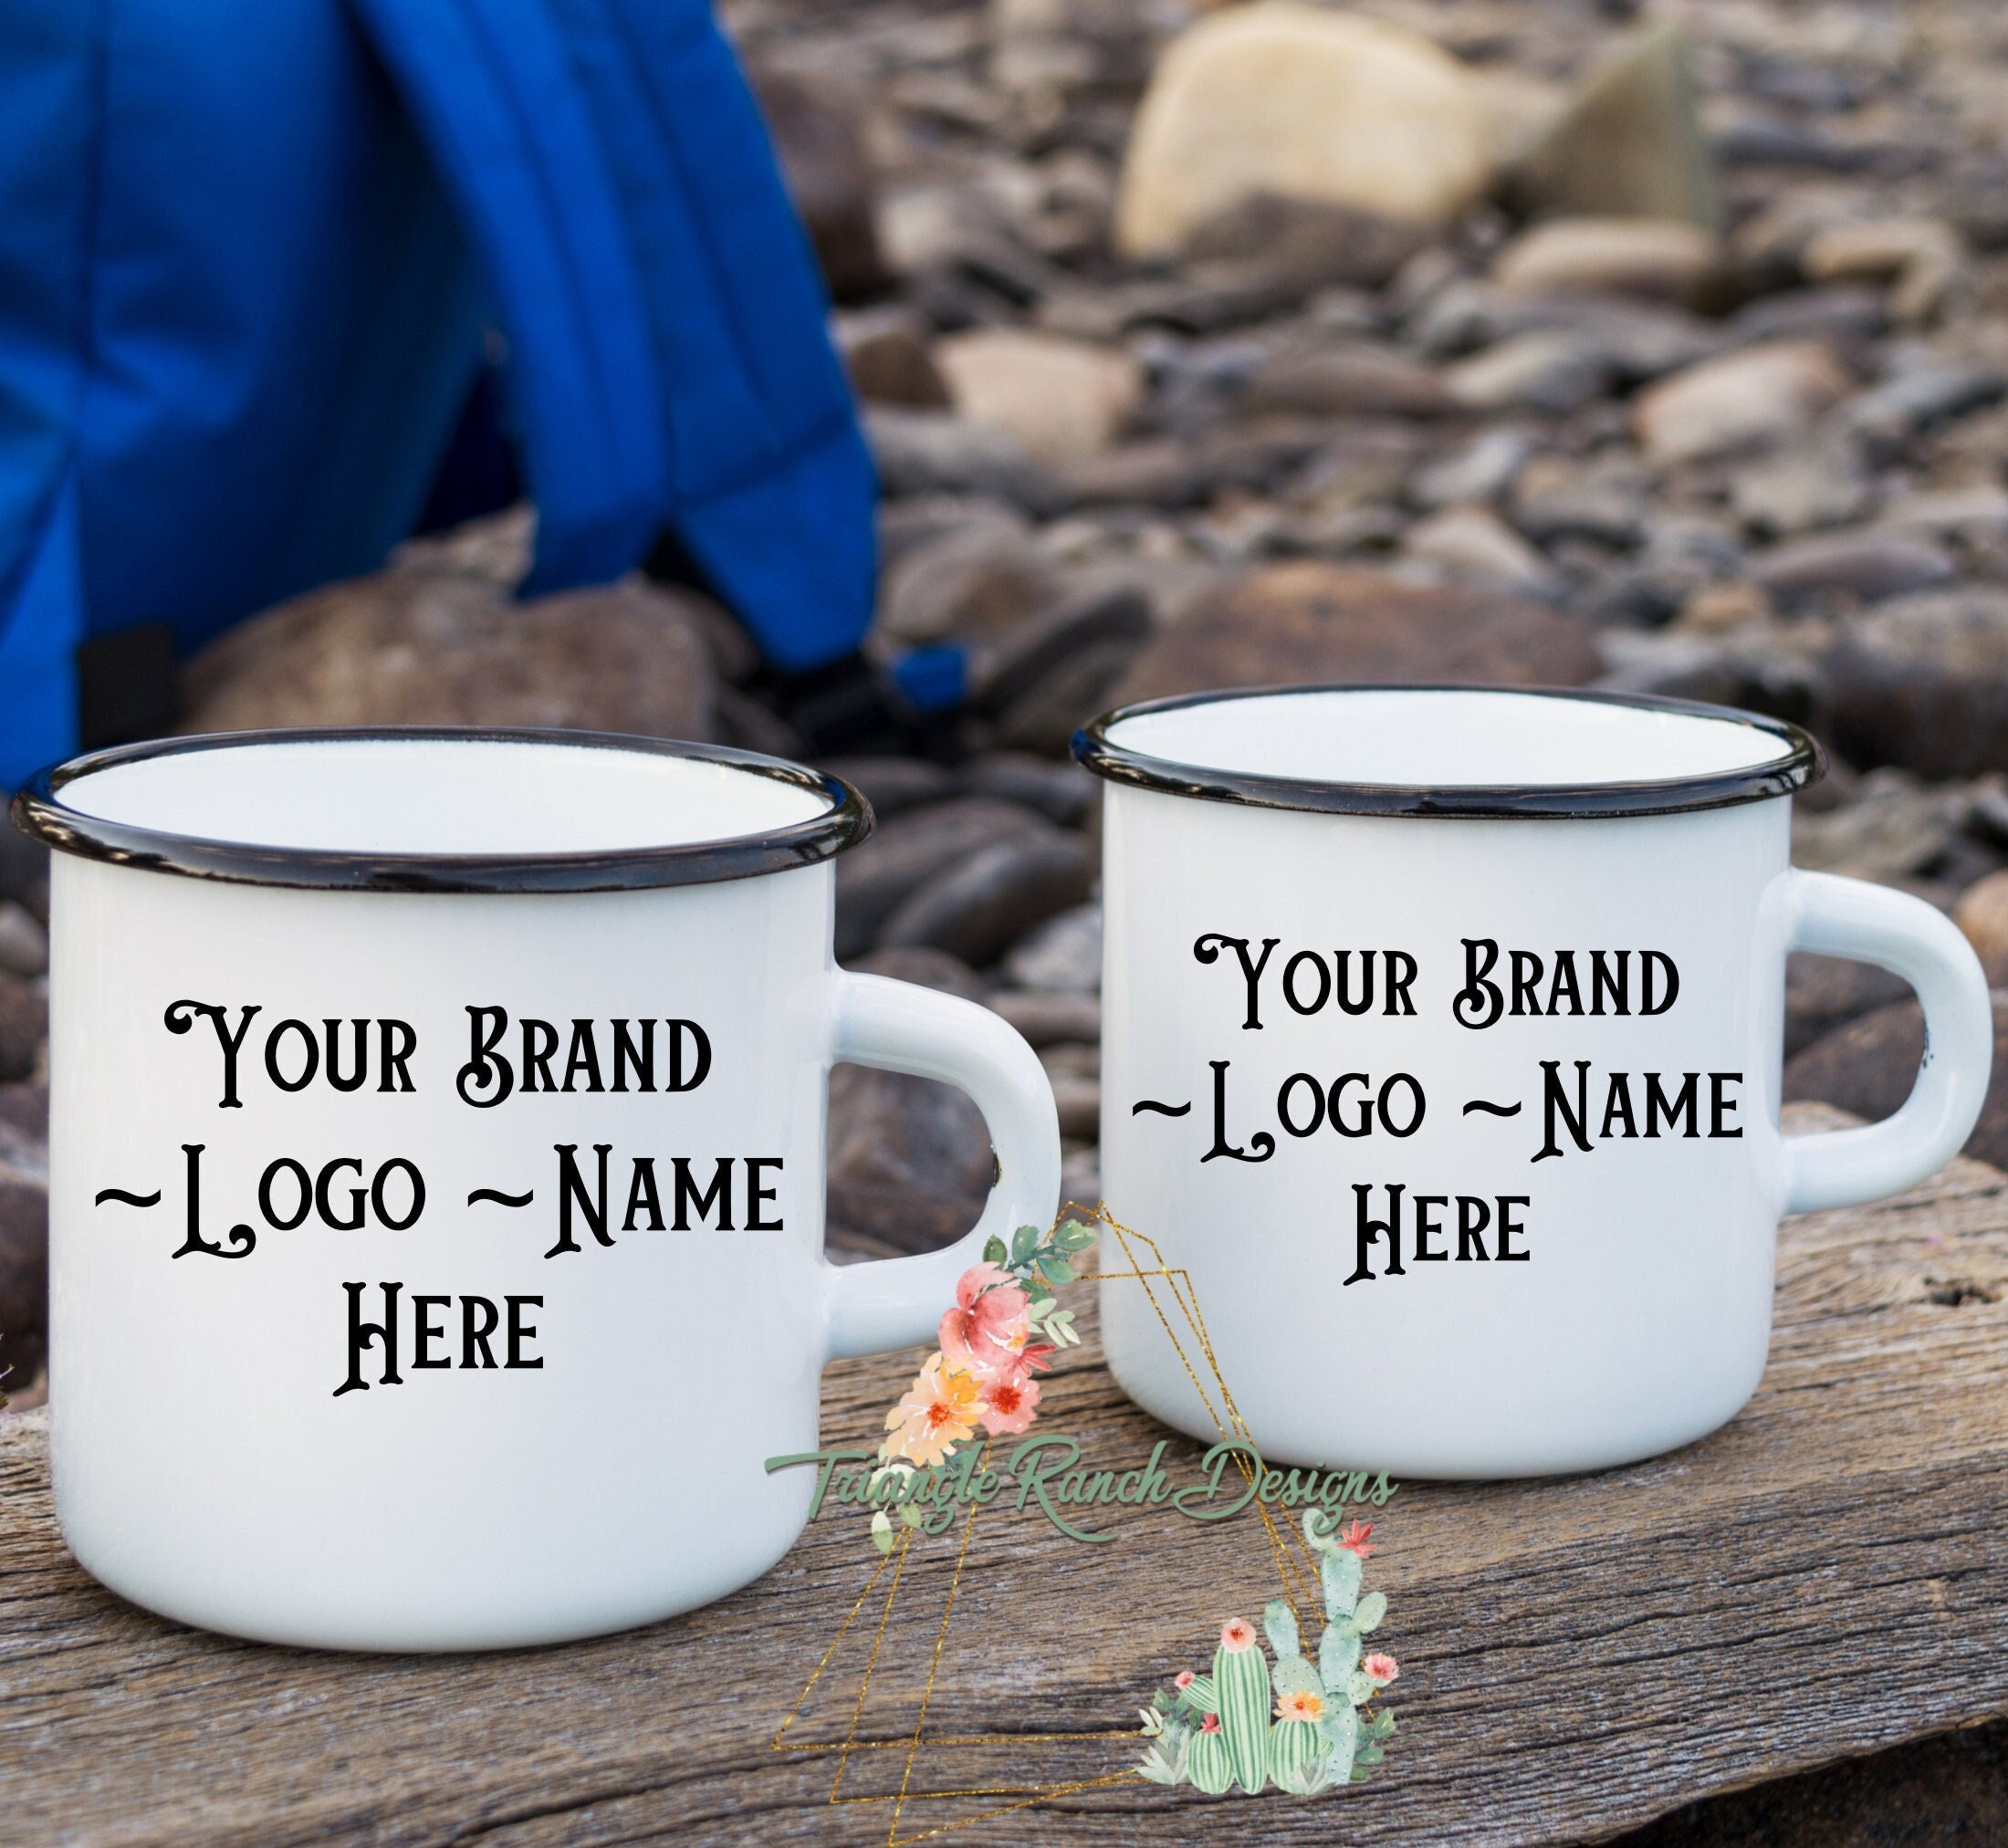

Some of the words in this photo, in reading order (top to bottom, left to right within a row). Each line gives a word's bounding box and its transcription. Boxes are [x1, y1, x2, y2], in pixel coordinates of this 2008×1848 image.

[1194, 934, 1418, 1030] YOUR
[1452, 938, 1679, 1030] BRAND
[163, 999, 417, 1109] YOUR
[455, 1005, 712, 1109] BRAND
[1343, 1184, 1531, 1287] HERE
[332, 1281, 544, 1397] HERE
